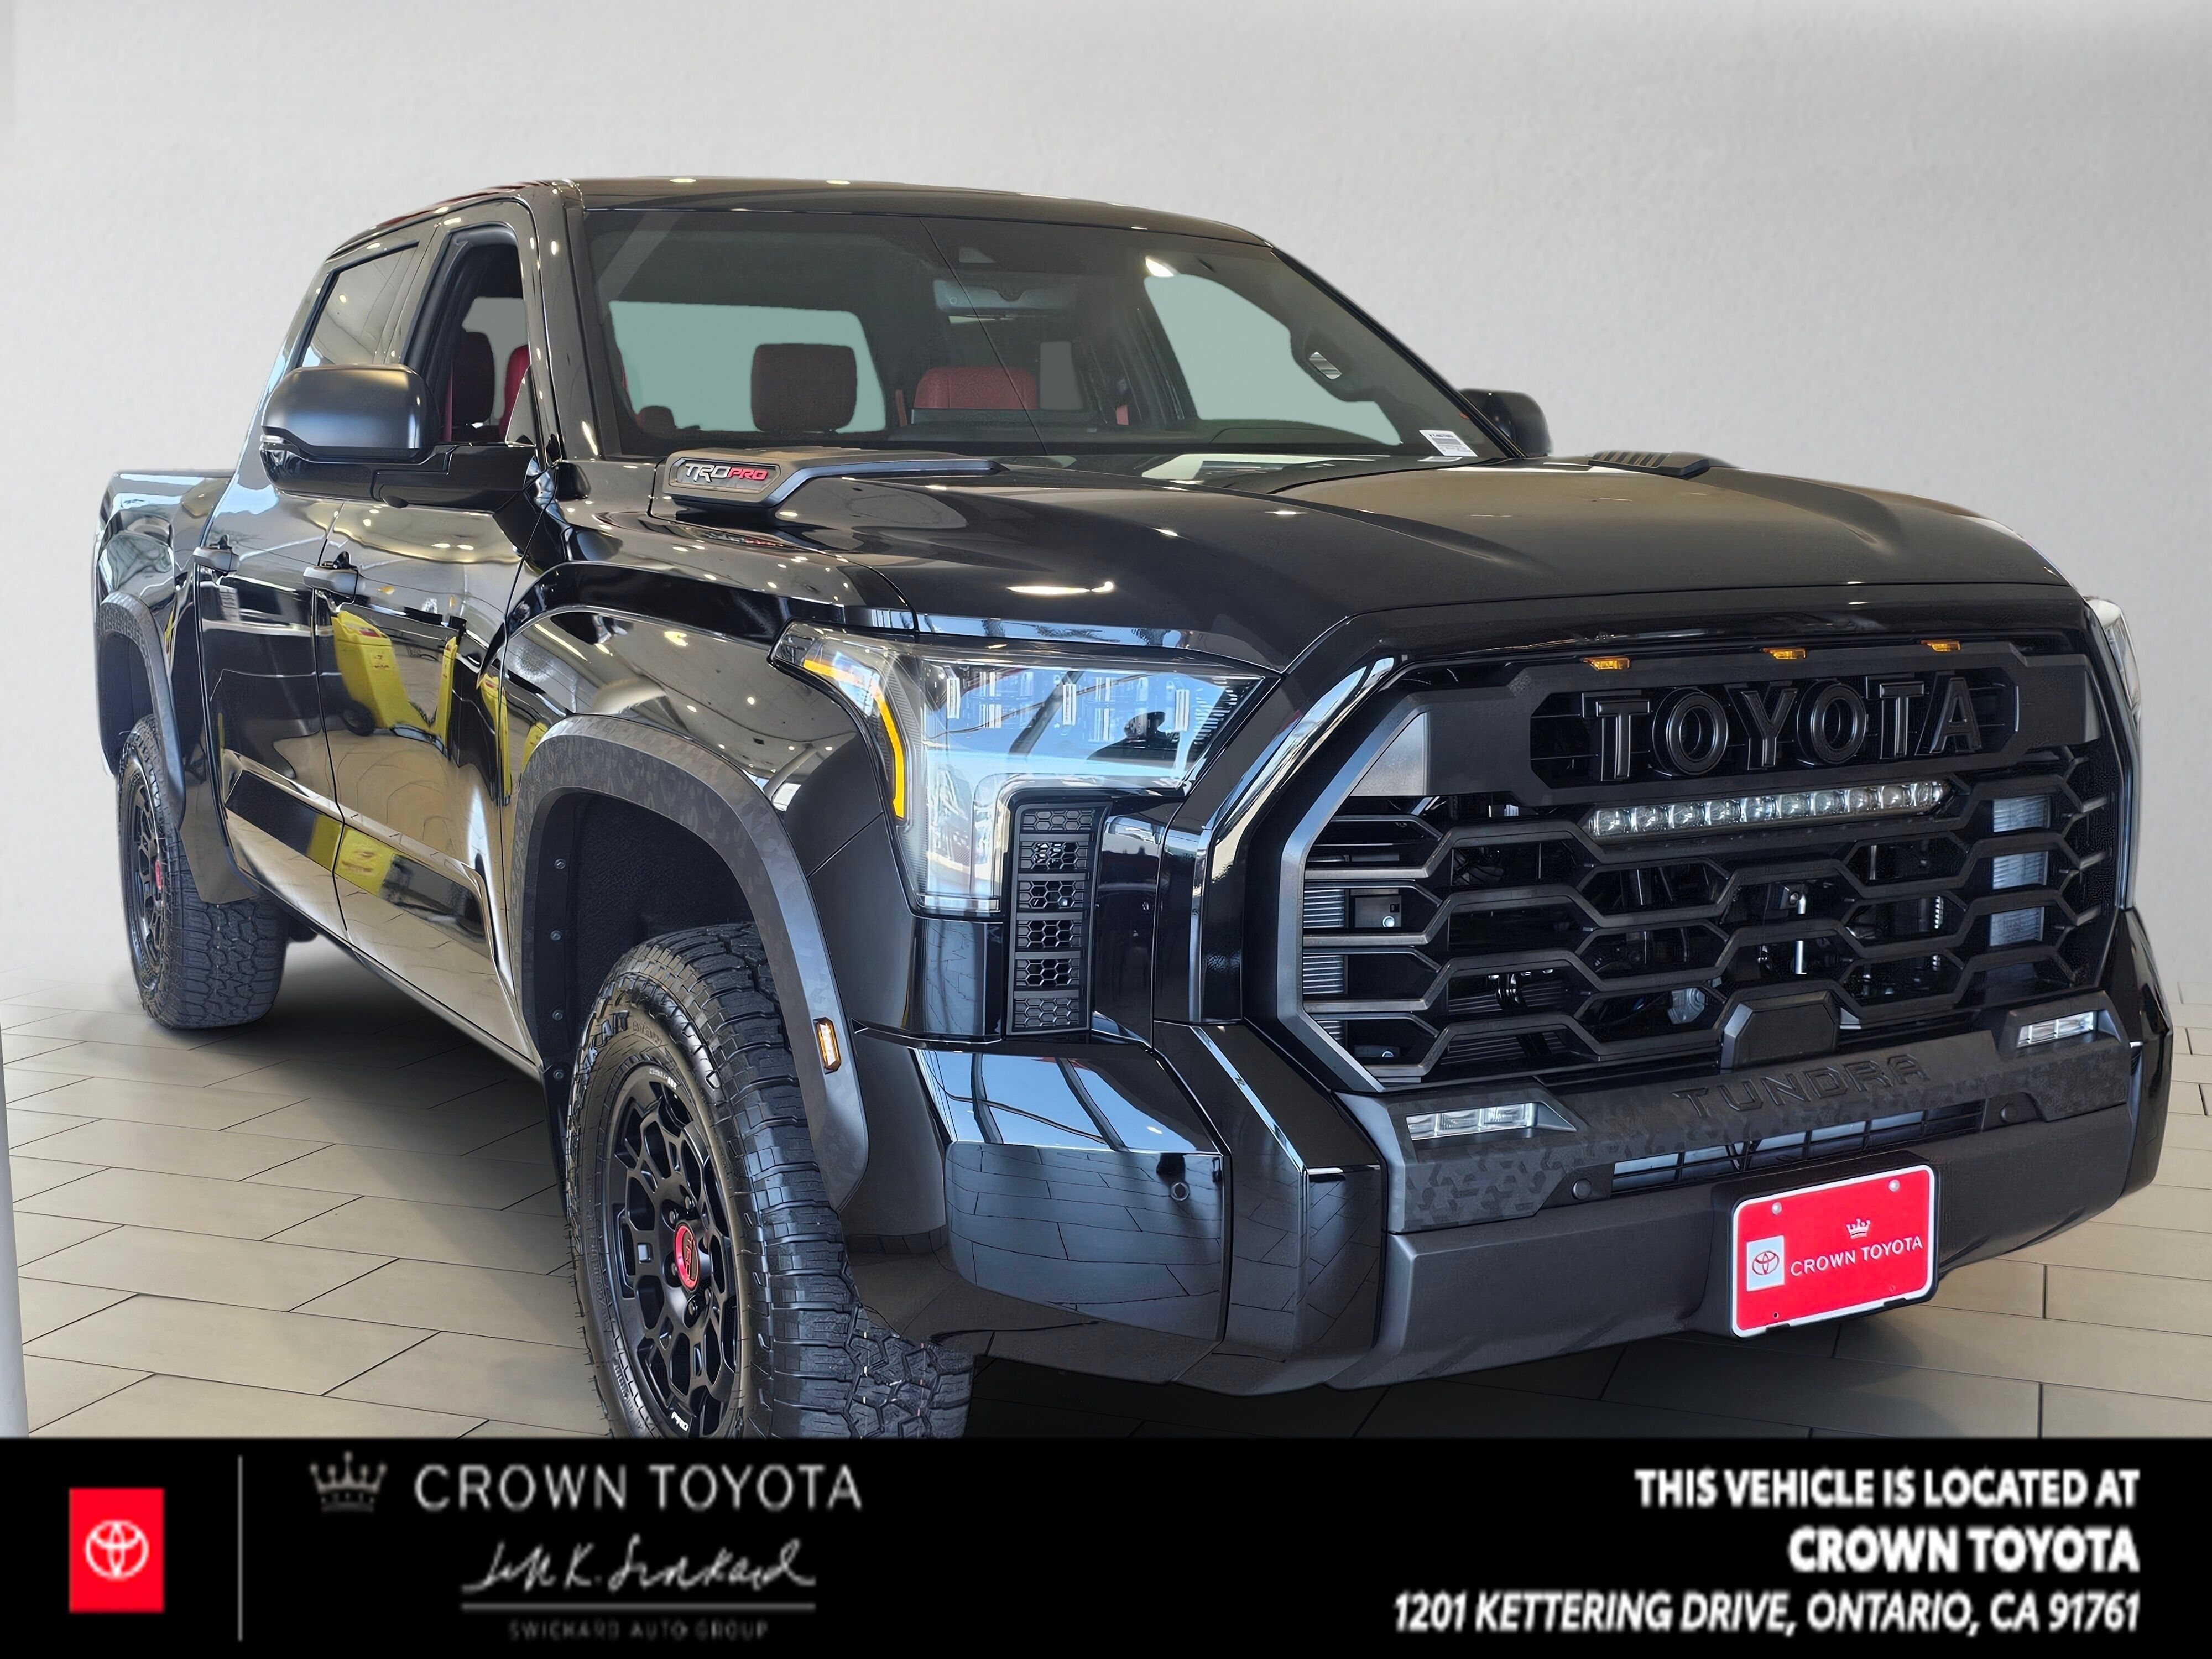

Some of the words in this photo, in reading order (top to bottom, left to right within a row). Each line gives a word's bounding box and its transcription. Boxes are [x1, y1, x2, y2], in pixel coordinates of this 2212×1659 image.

[1594, 677, 1983, 780] TOYOTA
[1672, 1053, 1930, 1118] TUNDRA
[1791, 1250, 1856, 1276] CROWN
[1861, 1235, 1923, 1261] TOYOTA
[671, 1411, 689, 1431] PRO
